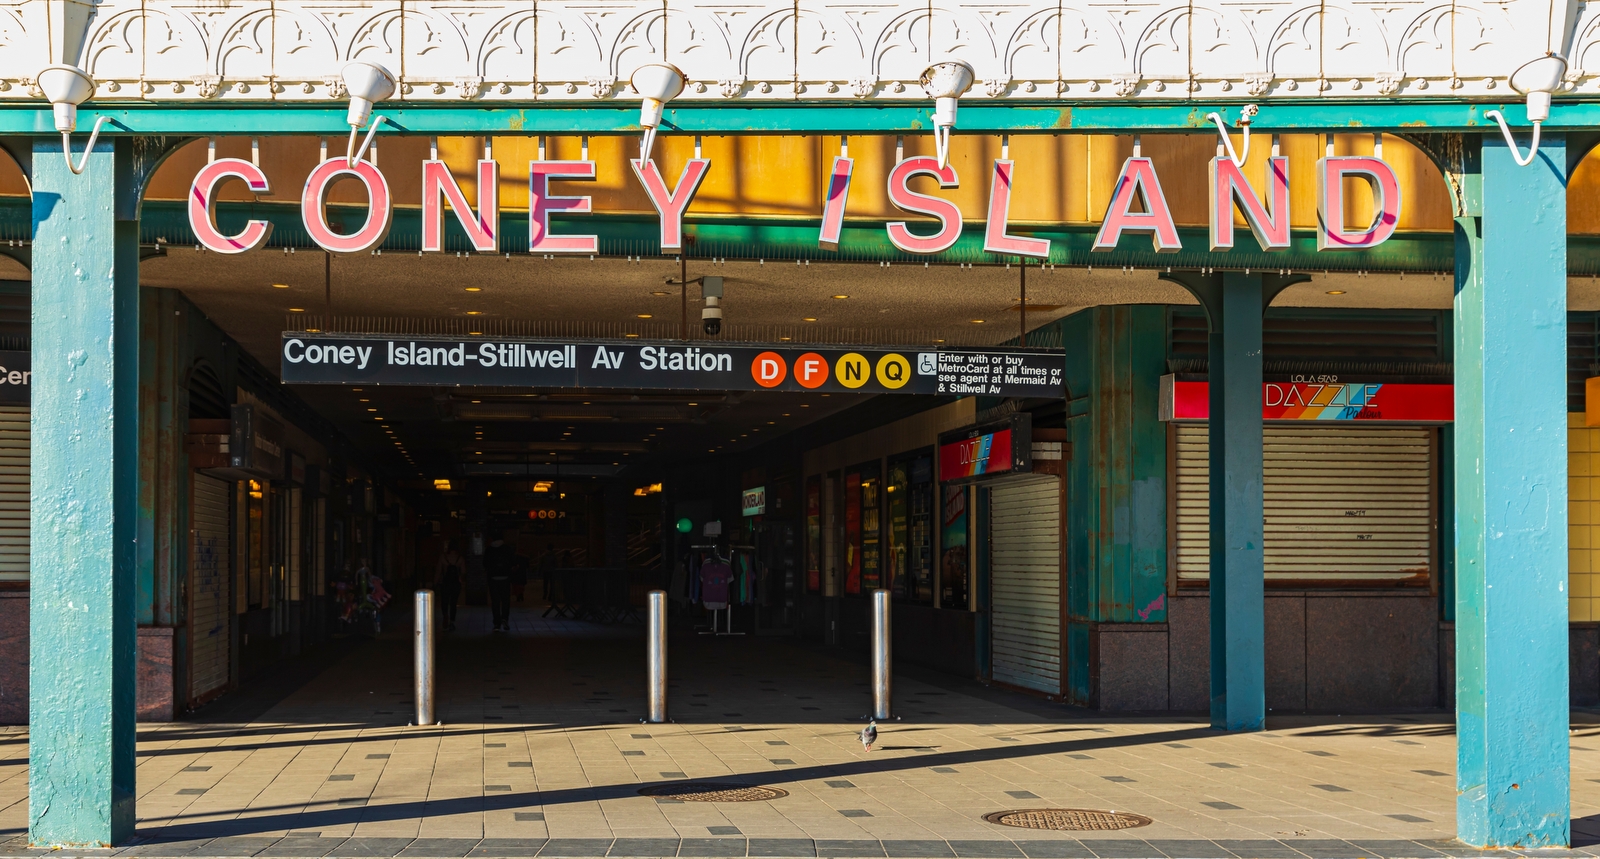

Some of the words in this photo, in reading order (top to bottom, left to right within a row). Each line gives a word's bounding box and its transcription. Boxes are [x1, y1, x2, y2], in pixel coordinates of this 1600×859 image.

[187, 157, 711, 254] CONEY
[818, 155, 1403, 258] ISLAND
[283, 338, 373, 370] Coney
[387, 341, 576, 367] Island-Stillwell
[591, 345, 624, 369] Av
[639, 346, 732, 371] Station
[761, 359, 779, 380] D
[804, 360, 820, 381] F
[845, 361, 861, 381] N
[884, 360, 903, 382] Q
[938, 353, 964, 363] Enter
[968, 354, 988, 364] with
[991, 356, 1003, 364] or
[1005, 355, 1024, 366] buy
[938, 363, 990, 374] MetroCard
[993, 365, 1003, 374] at
[1006, 365, 1017, 375] all
[1020, 366, 1048, 376] times
[1050, 368, 1062, 376] or
[938, 374, 957, 382] see
[960, 374, 988, 384] agent
[991, 375, 1002, 383] at
[1004, 375, 1047, 385] Mermaid
[1049, 376, 1062, 386] Av
[1290, 374, 1316, 383] LOLA
[1317, 374, 1338, 383] STAR
[937, 383, 946, 392] &
[949, 383, 986, 393] Stillwell
[988, 385, 1001, 394] Av
[1265, 383, 1379, 407] DAZZLE
[1343, 406, 1382, 419] Parlour
[960, 437, 991, 465] DAZZLE
